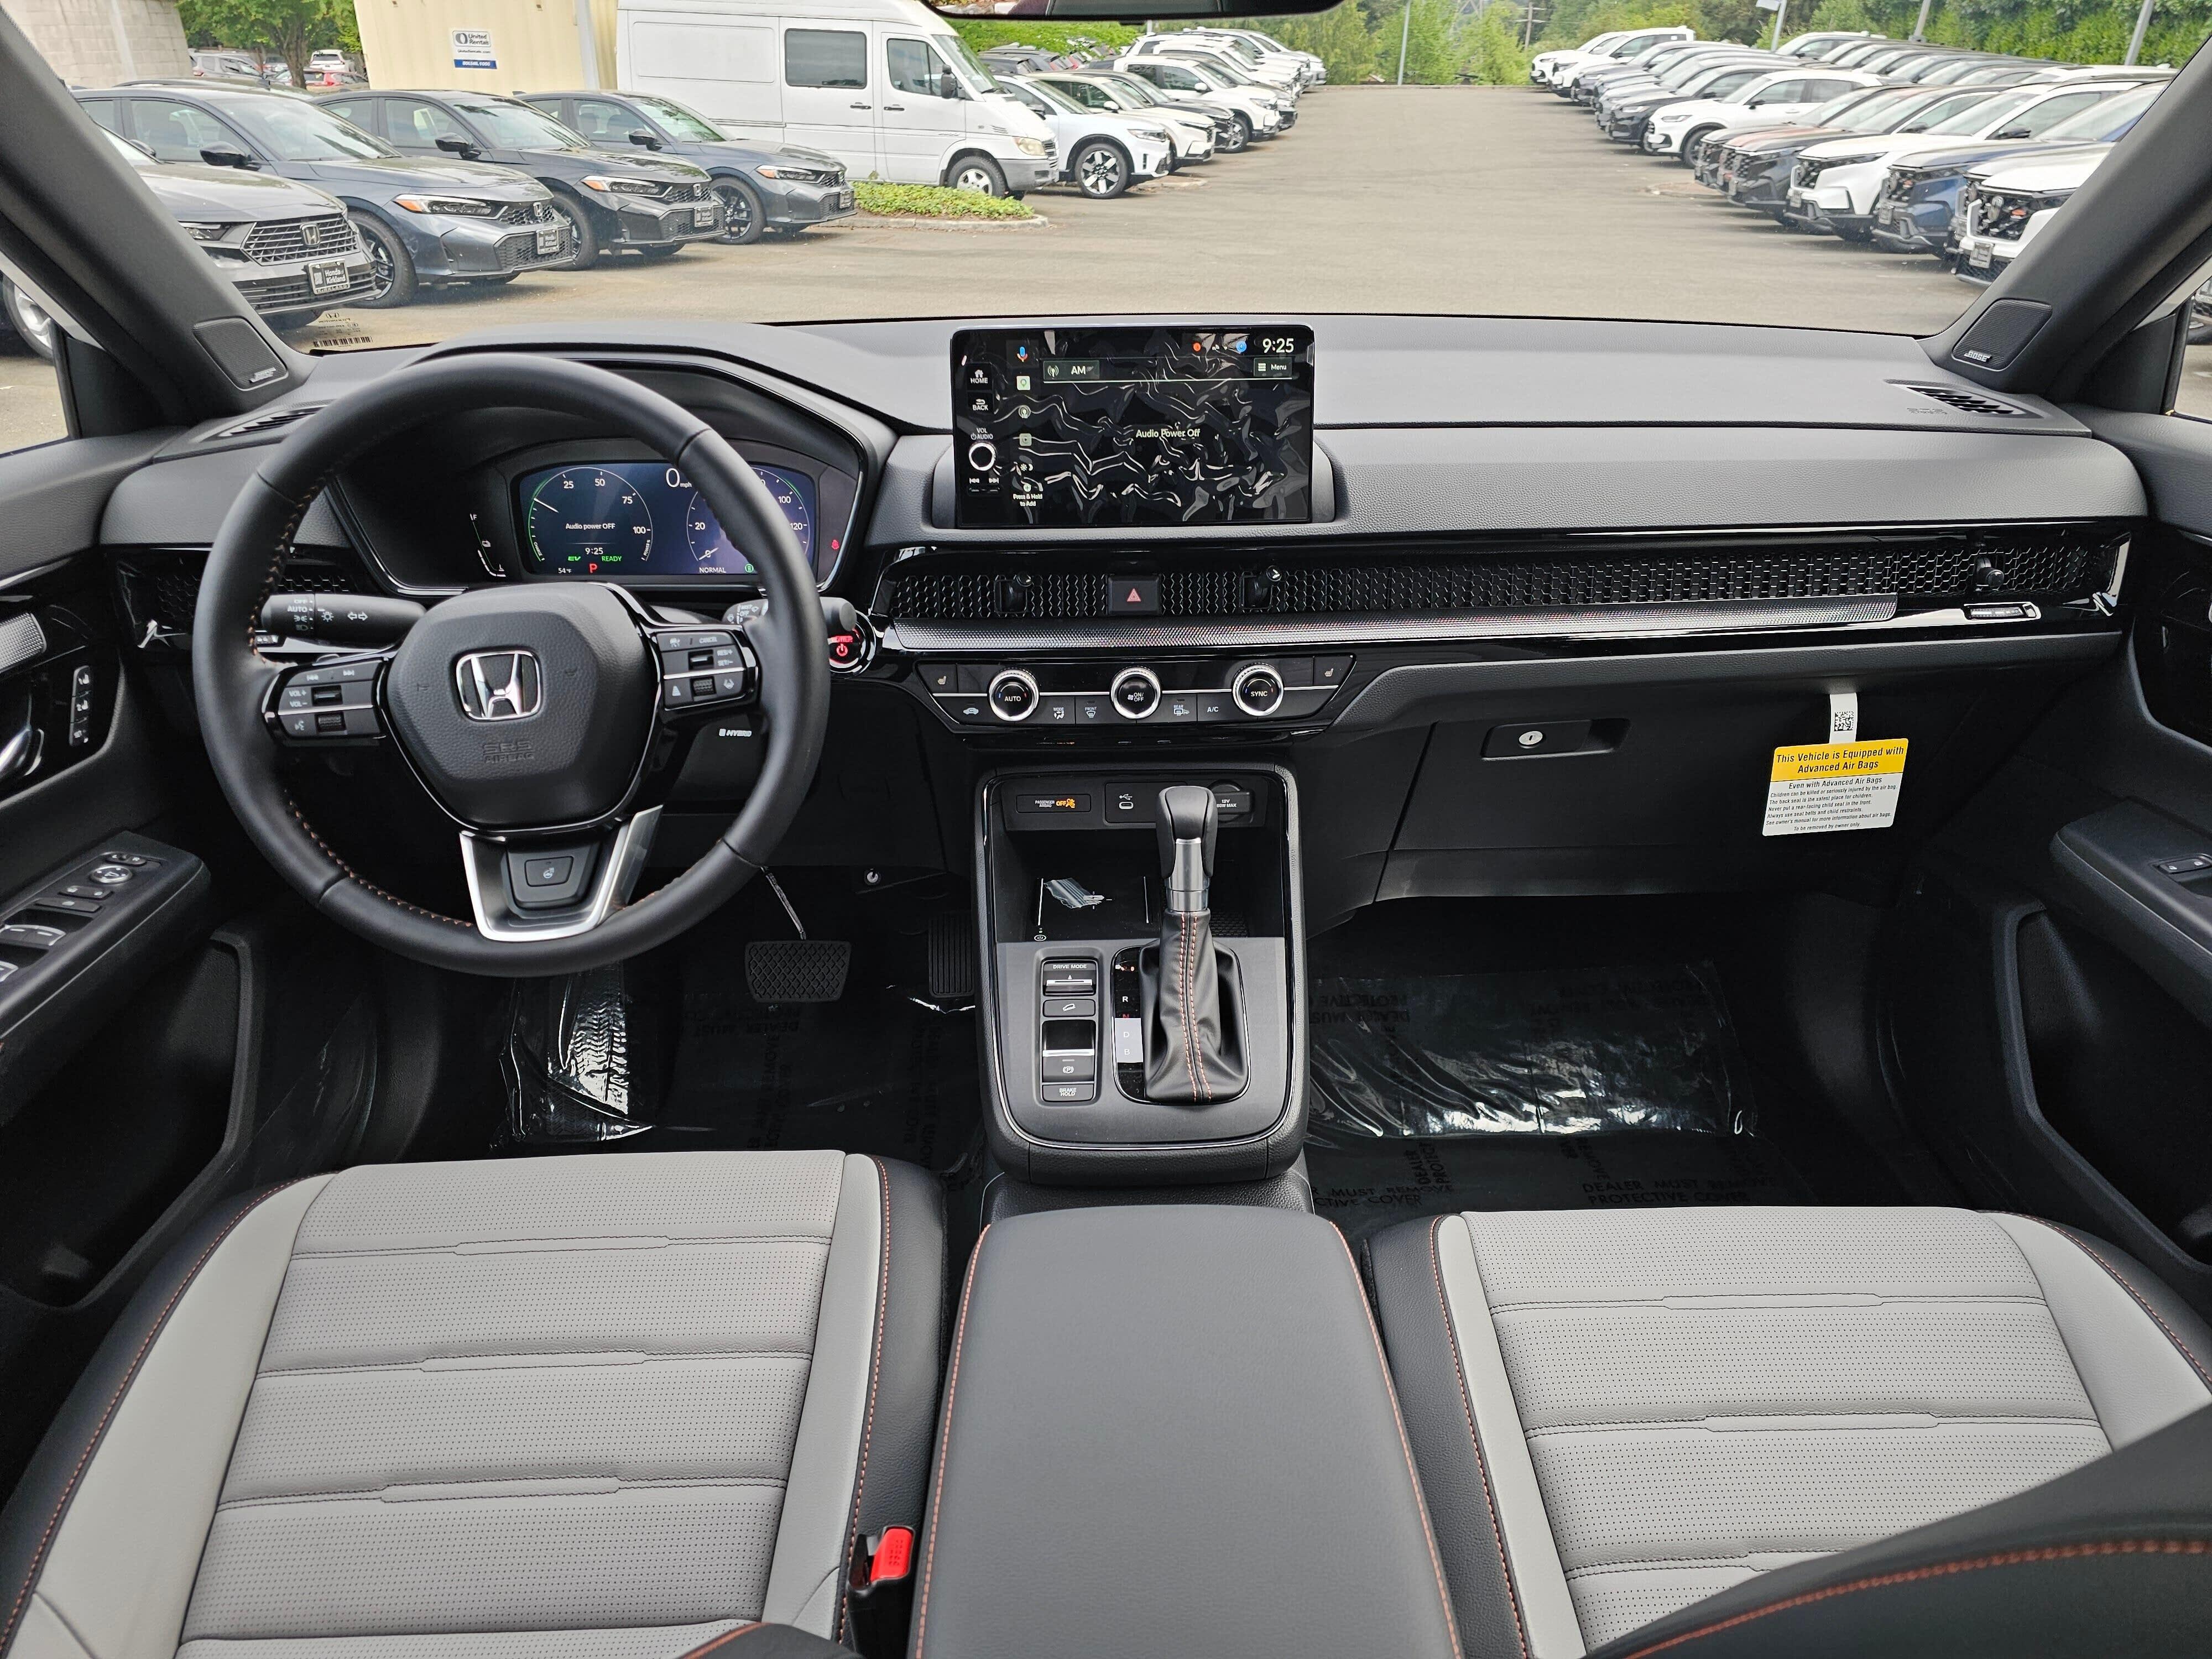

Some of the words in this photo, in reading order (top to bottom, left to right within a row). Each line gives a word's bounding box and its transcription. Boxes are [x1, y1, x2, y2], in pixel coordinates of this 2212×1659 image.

[1262, 338, 1295, 353] 9:25
[1964, 349, 1991, 362] BOSE
[1071, 366, 1086, 375] AM
[1136, 429, 1159, 438] Audio
[1161, 429, 1186, 437] Power
[1187, 429, 1201, 437] Off
[594, 478, 605, 487] 50
[778, 495, 791, 504] 100
[632, 526, 646, 534] 100
[695, 522, 706, 530] 20
[589, 564, 598, 573] P
[1777, 754, 1794, 763] This
[1798, 752, 1829, 761] Vehicle
[1833, 750, 1840, 759] is
[1843, 748, 1884, 759] Equipped
[1886, 747, 1904, 755] with
[1797, 763, 1840, 773] Advanced
[1842, 761, 1855, 770] Air
[1858, 760, 1879, 770] Bags
[1822, 779, 1853, 787] Advanced
[1331, 1187, 1375, 1198] MUST
[1368, 1193, 1423, 1206] COVER
[1588, 1192, 1688, 1206] PROTECTIVE
